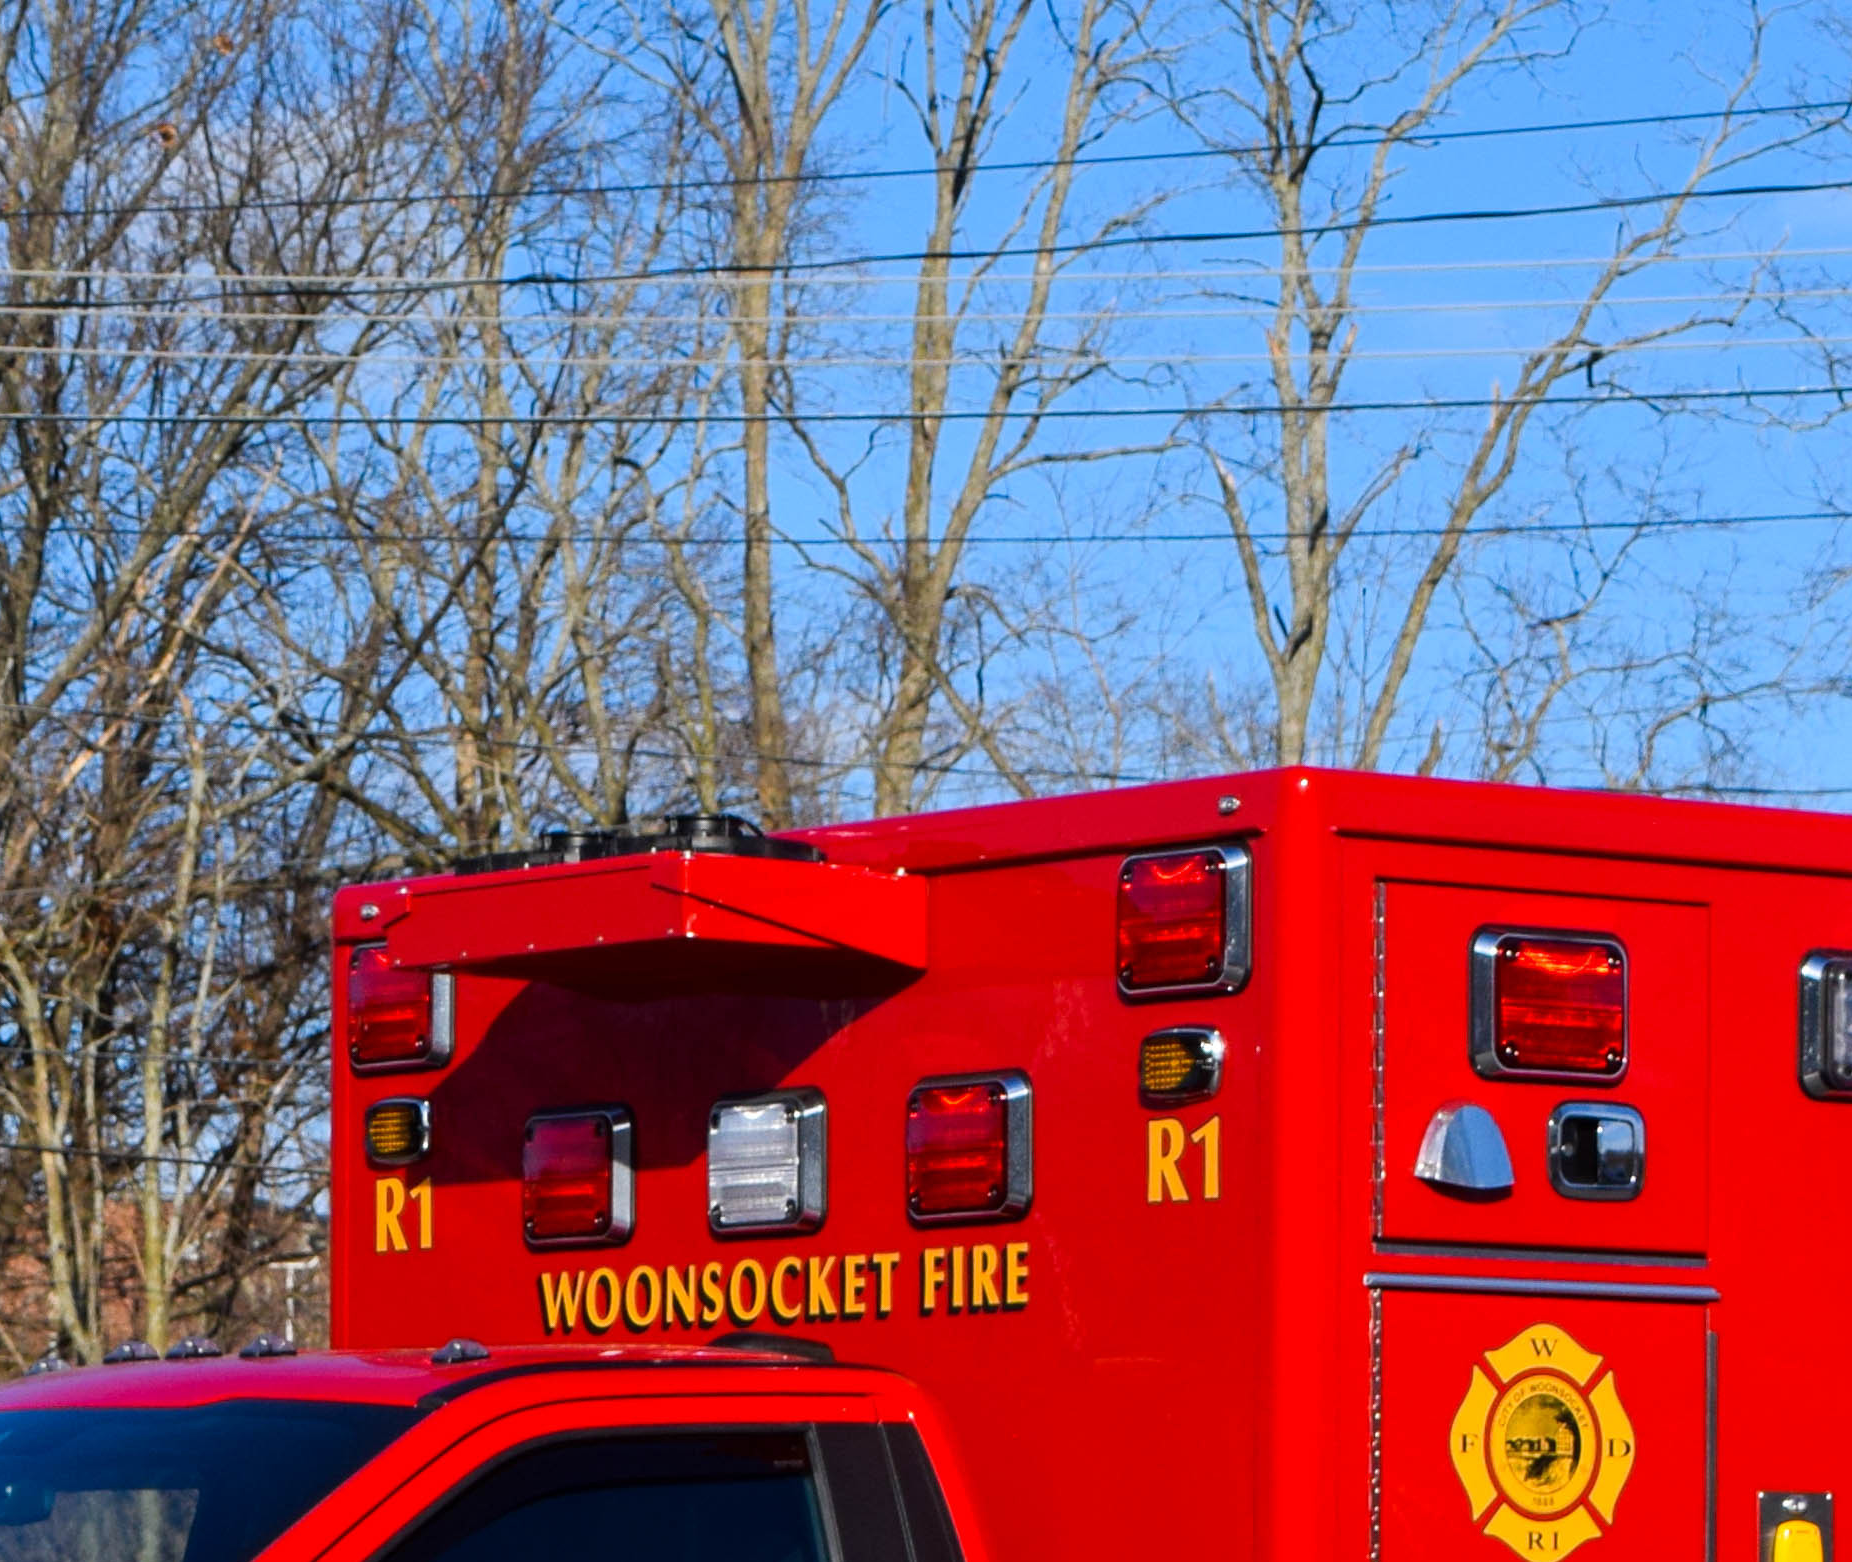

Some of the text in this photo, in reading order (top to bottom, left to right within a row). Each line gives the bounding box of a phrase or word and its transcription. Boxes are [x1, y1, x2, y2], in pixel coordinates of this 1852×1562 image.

[1147, 1116, 1222, 1203] R1
[375, 1177, 433, 1253] R1
[540, 1242, 1030, 1332] WOONSOCKET FIRE
[1531, 1338, 1557, 1357] W
[1529, 1382, 1589, 1428] WOONSOCKET
[1461, 1434, 1479, 1453] F
[1608, 1439, 1632, 1458] D
